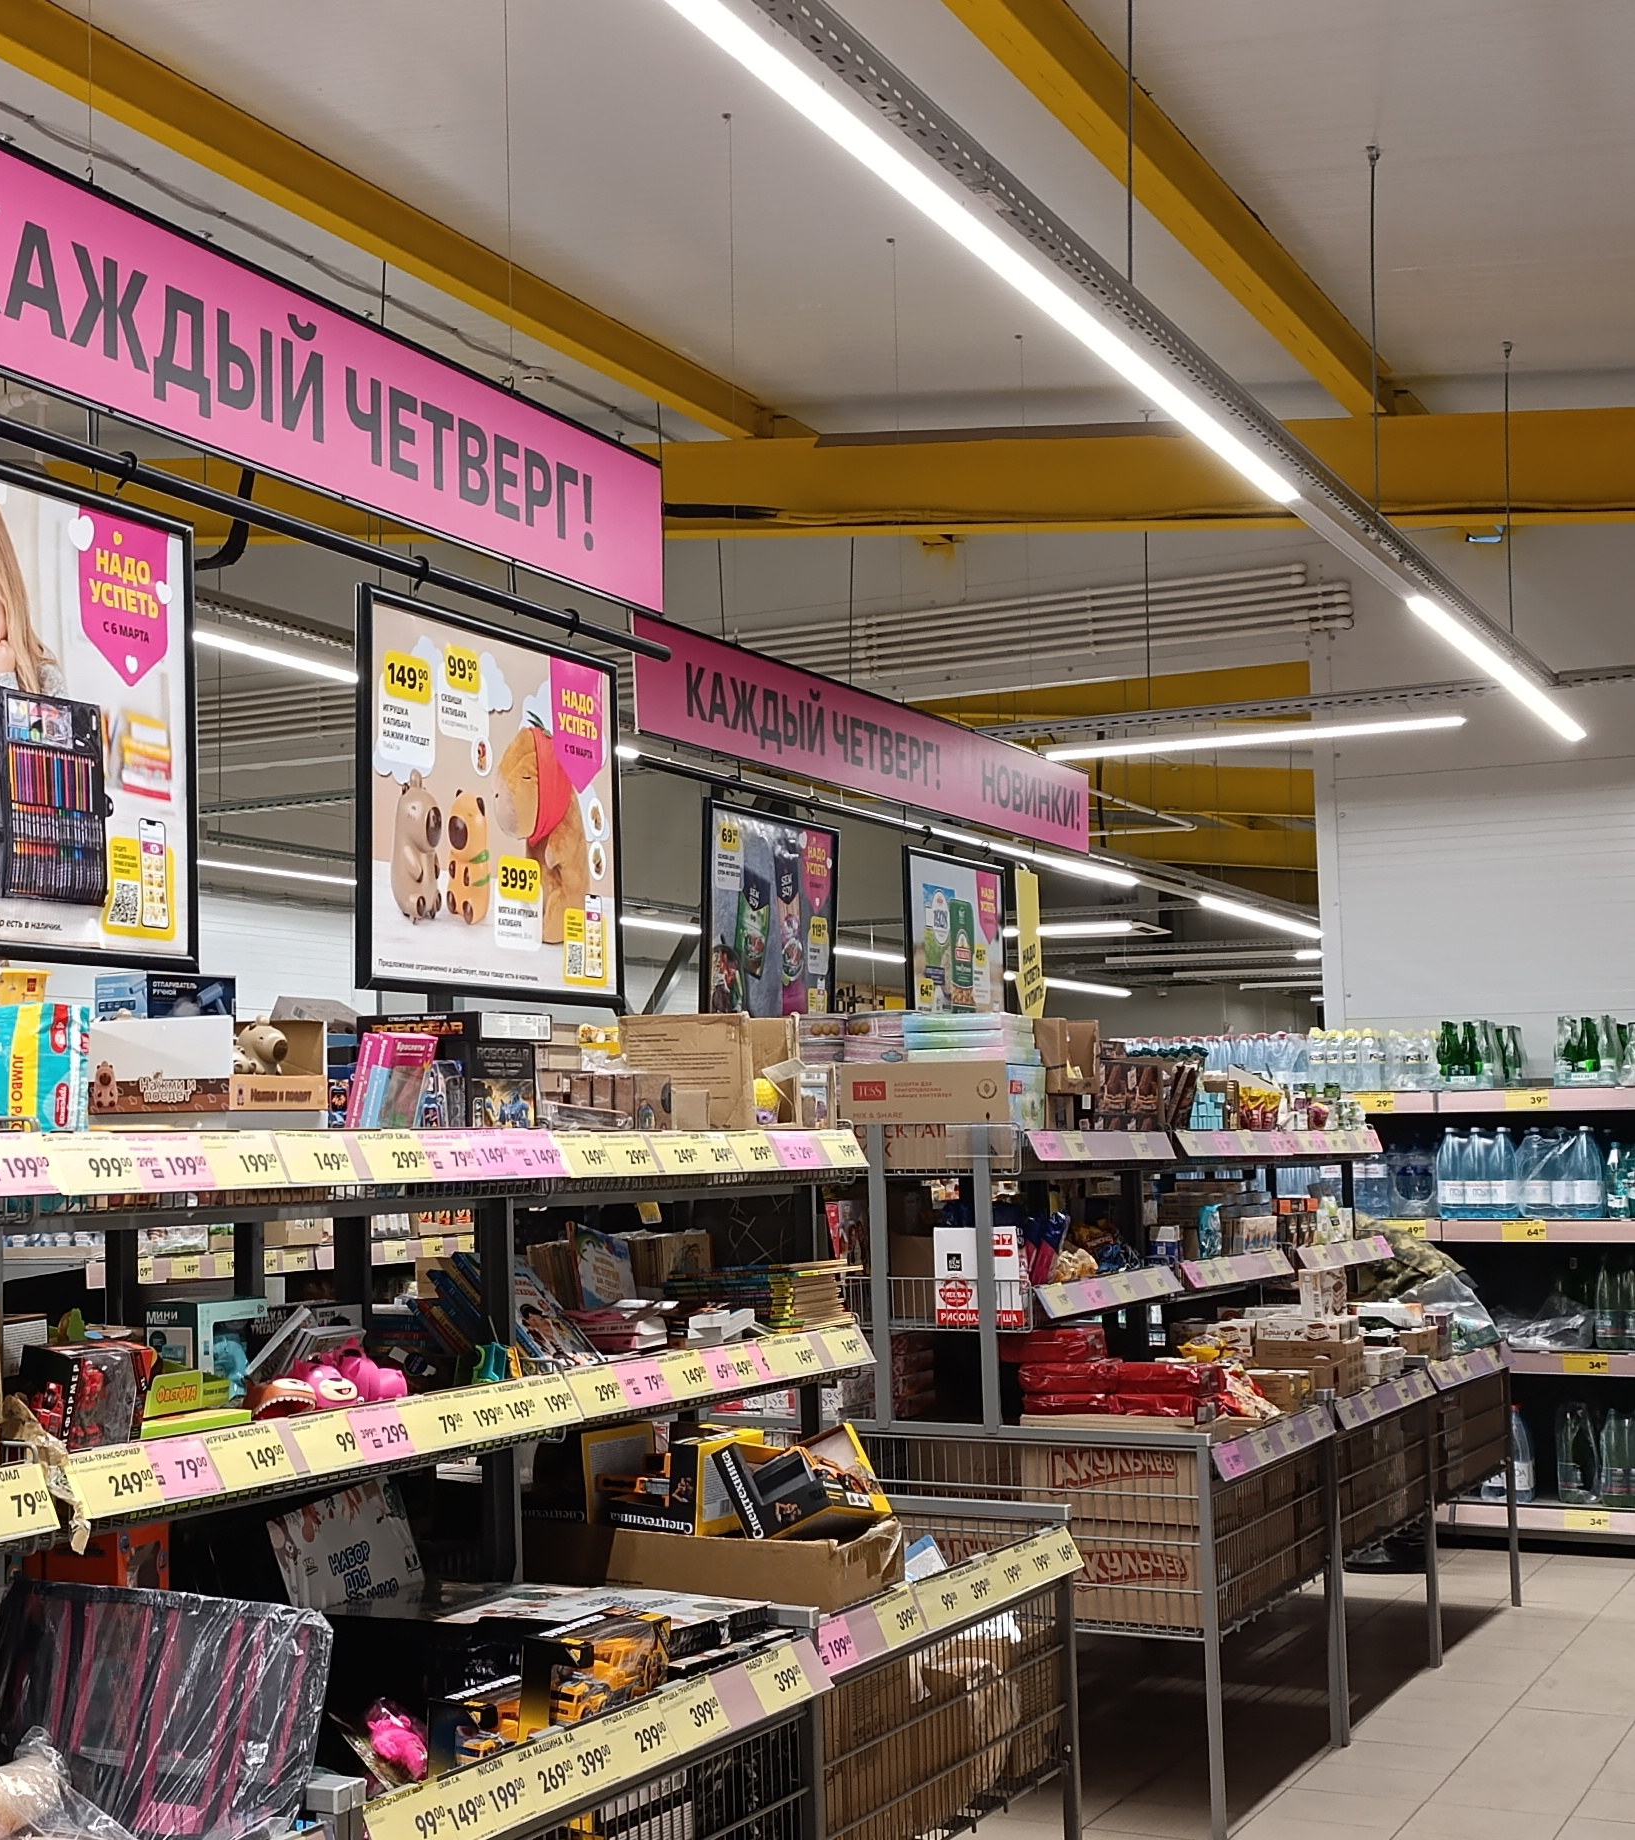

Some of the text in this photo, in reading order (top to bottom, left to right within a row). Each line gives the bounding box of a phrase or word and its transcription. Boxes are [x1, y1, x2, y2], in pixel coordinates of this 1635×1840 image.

[345, 366, 595, 552] ЧЕТВЕРГ!
[95, 547, 150, 586] НАДО
[89, 578, 159, 619] УСПЕТЬ
[103, 621, 150, 644] С 6 МАРТА
[383, 704, 408, 716] ИГРУШКА
[562, 689, 594, 716] НАДО
[383, 716, 411, 729] КАПИБАРА
[558, 712, 598, 740] УСПЕТЬ
[685, 662, 1081, 832] КАЖДЫЙ ЧЕТВЕРГ! НОВИНКИ!
[808, 846, 826, 861] НАДО
[806, 862, 828, 877] УСПЕТЬ
[1022, 943, 1036, 964] НАДО
[152, 981, 198, 989] ОТПАРИВАТЕЛЬ
[1024, 964, 1040, 988] УСПЕТЬ
[152, 988, 177, 996] РУЧНОЙ
[1025, 984, 1044, 1010] КУПИТЬ!
[12, 1054, 24, 1103] JUMBO
[139, 1077, 185, 1091] Нажми
[857, 1086, 882, 1098] TESS
[205, 1425, 271, 1445] ИГРУШКА ФАСТФУД
[69, 1447, 141, 1465] РУШКА-ТРАНСФОРМЕР
[1054, 1451, 1175, 1486] АКУЛЬЧЕВ
[720, 1449, 765, 1540] Спецтехника
[609, 1512, 694, 1535] Спецтехника
[328, 1540, 370, 1576] НАБОР
[344, 1566, 371, 1598] ДЛЯ
[745, 1656, 763, 1672] НАБОР
[534, 1738, 563, 1755] МАШИНА
